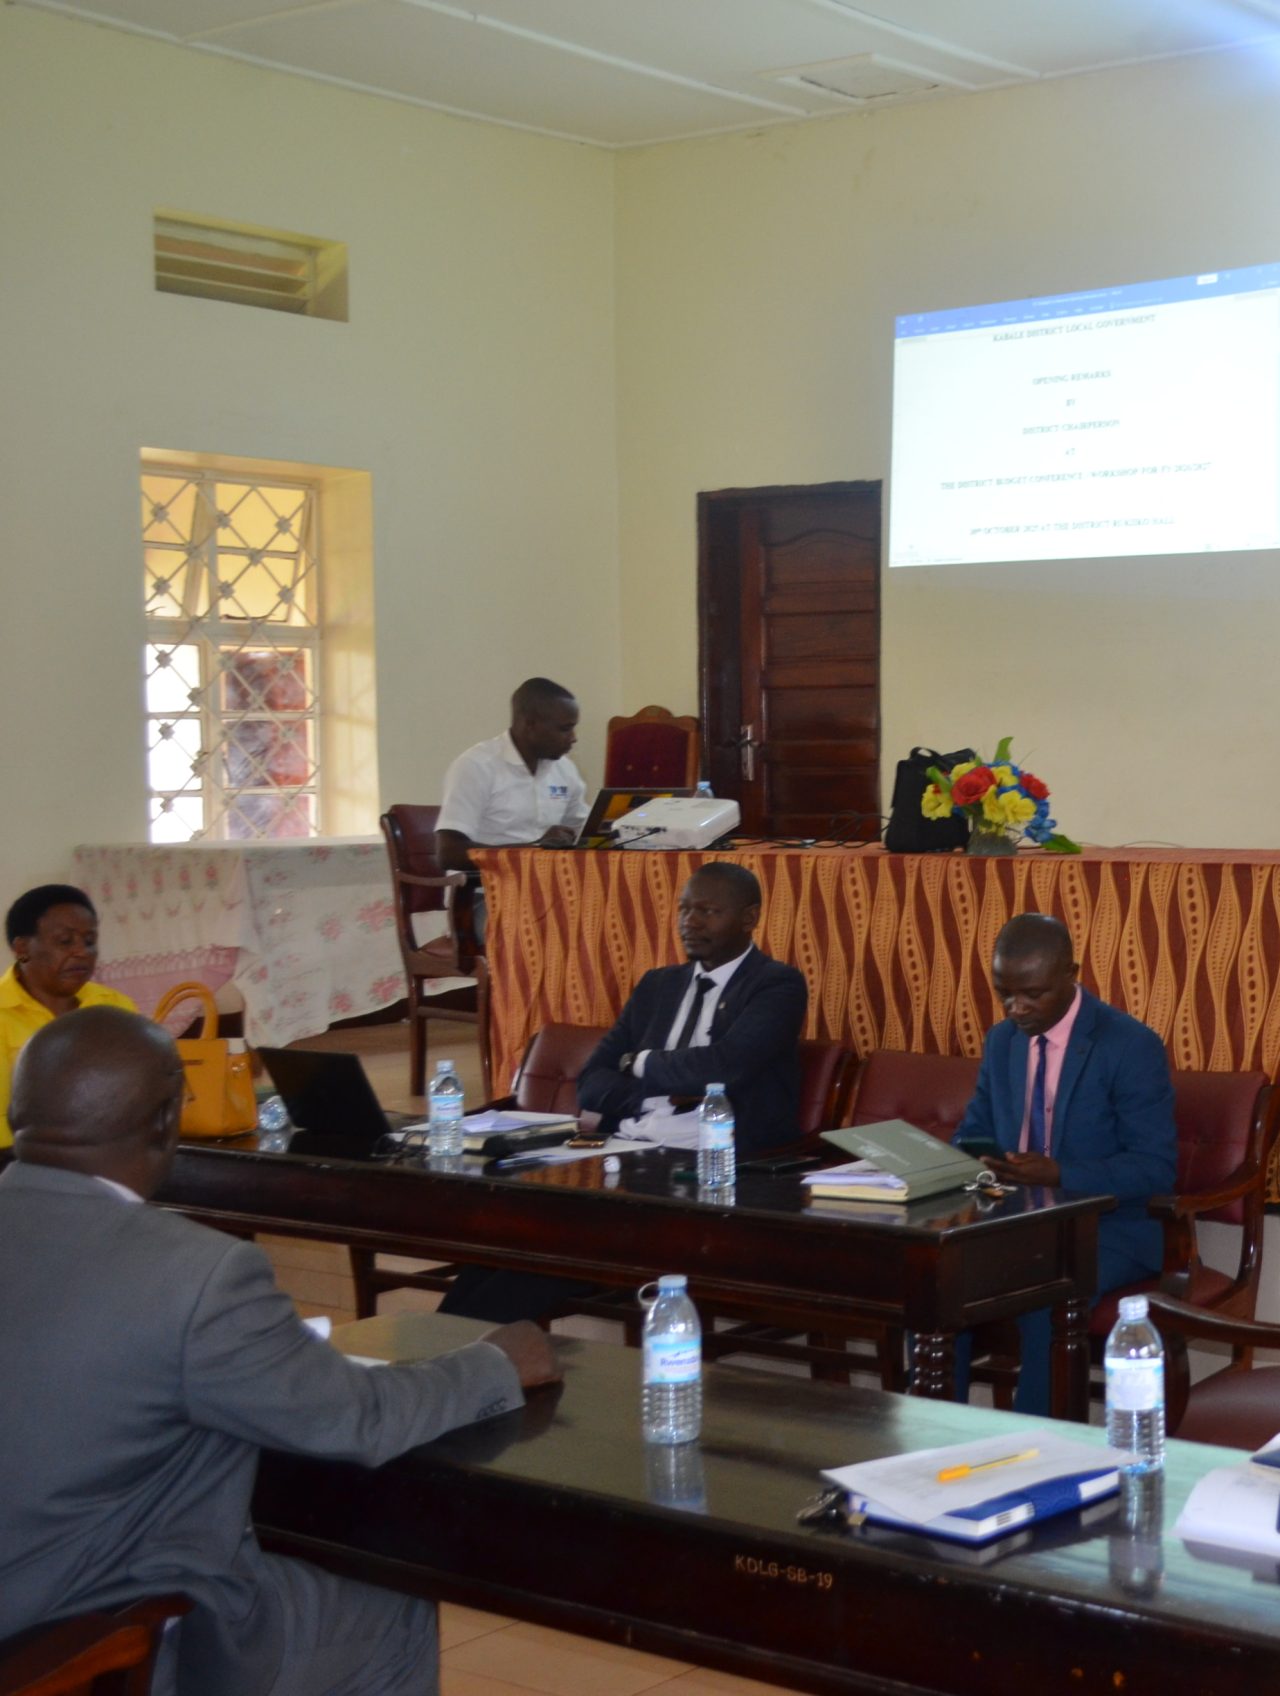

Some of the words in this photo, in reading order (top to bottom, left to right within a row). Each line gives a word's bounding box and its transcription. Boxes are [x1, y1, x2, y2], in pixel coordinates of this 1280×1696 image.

[992, 329, 1024, 342] KABALE
[1026, 325, 1064, 338] DISTRICT
[1065, 322, 1093, 333] LOCAL
[1095, 313, 1157, 330] GOVERNMENT
[1032, 374, 1068, 385] OPENING
[1071, 369, 1112, 382] REMARKS
[1022, 424, 1059, 435] DISTRICT
[1061, 419, 1121, 431] CHAIRPERSON
[940, 481, 956, 490] THE
[958, 478, 993, 489] DISTRICT
[996, 475, 1028, 486] BUDGET
[1071, 519, 1109, 530] DISTRICT
